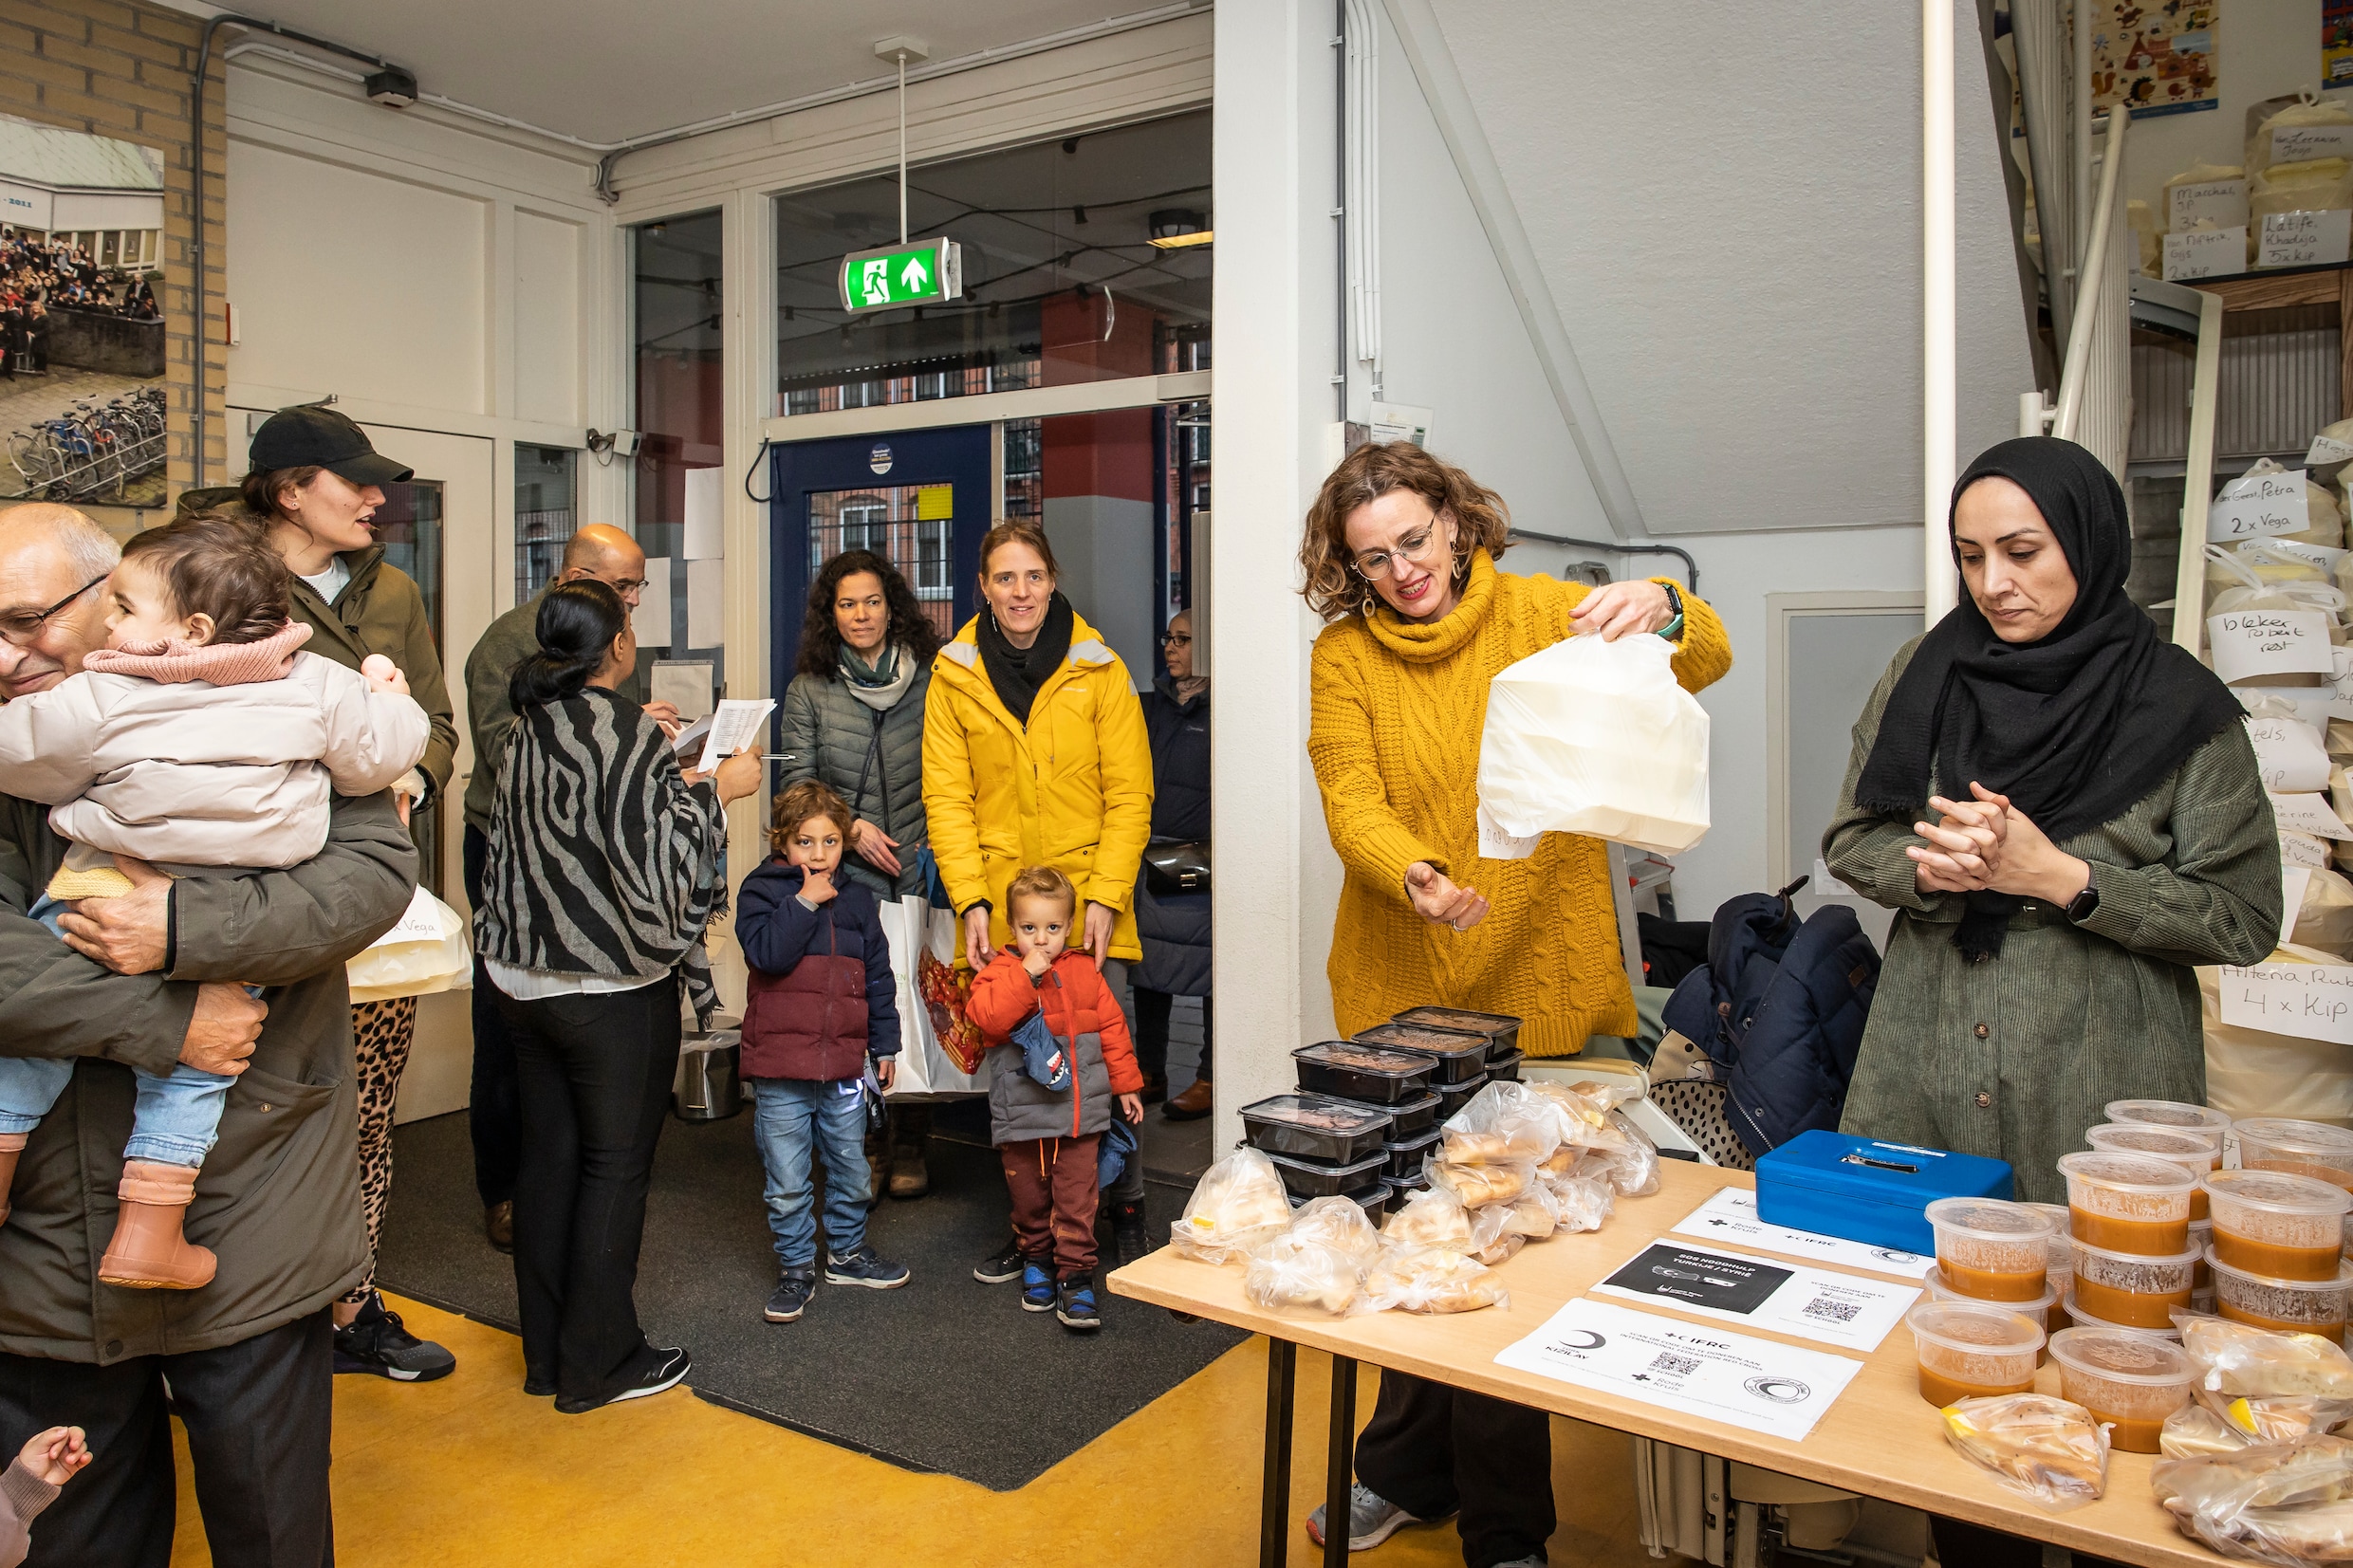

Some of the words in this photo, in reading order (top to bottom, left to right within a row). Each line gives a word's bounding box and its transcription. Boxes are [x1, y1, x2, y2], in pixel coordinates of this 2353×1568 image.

[9, 197, 32, 209] 2011
[2261, 480, 2295, 500] Petra
[2260, 512, 2290, 528] Vega
[2260, 641, 2295, 653] rest
[403, 919, 435, 935] Vega
[2244, 988, 2266, 1014] 4
[2305, 993, 2347, 1023] Kip
[1806, 1238, 1837, 1246] IFRC
[1690, 1337, 1732, 1350] IFRC
[1653, 1382, 1679, 1392] Kruis
[1657, 1378, 1684, 1388] Rode
